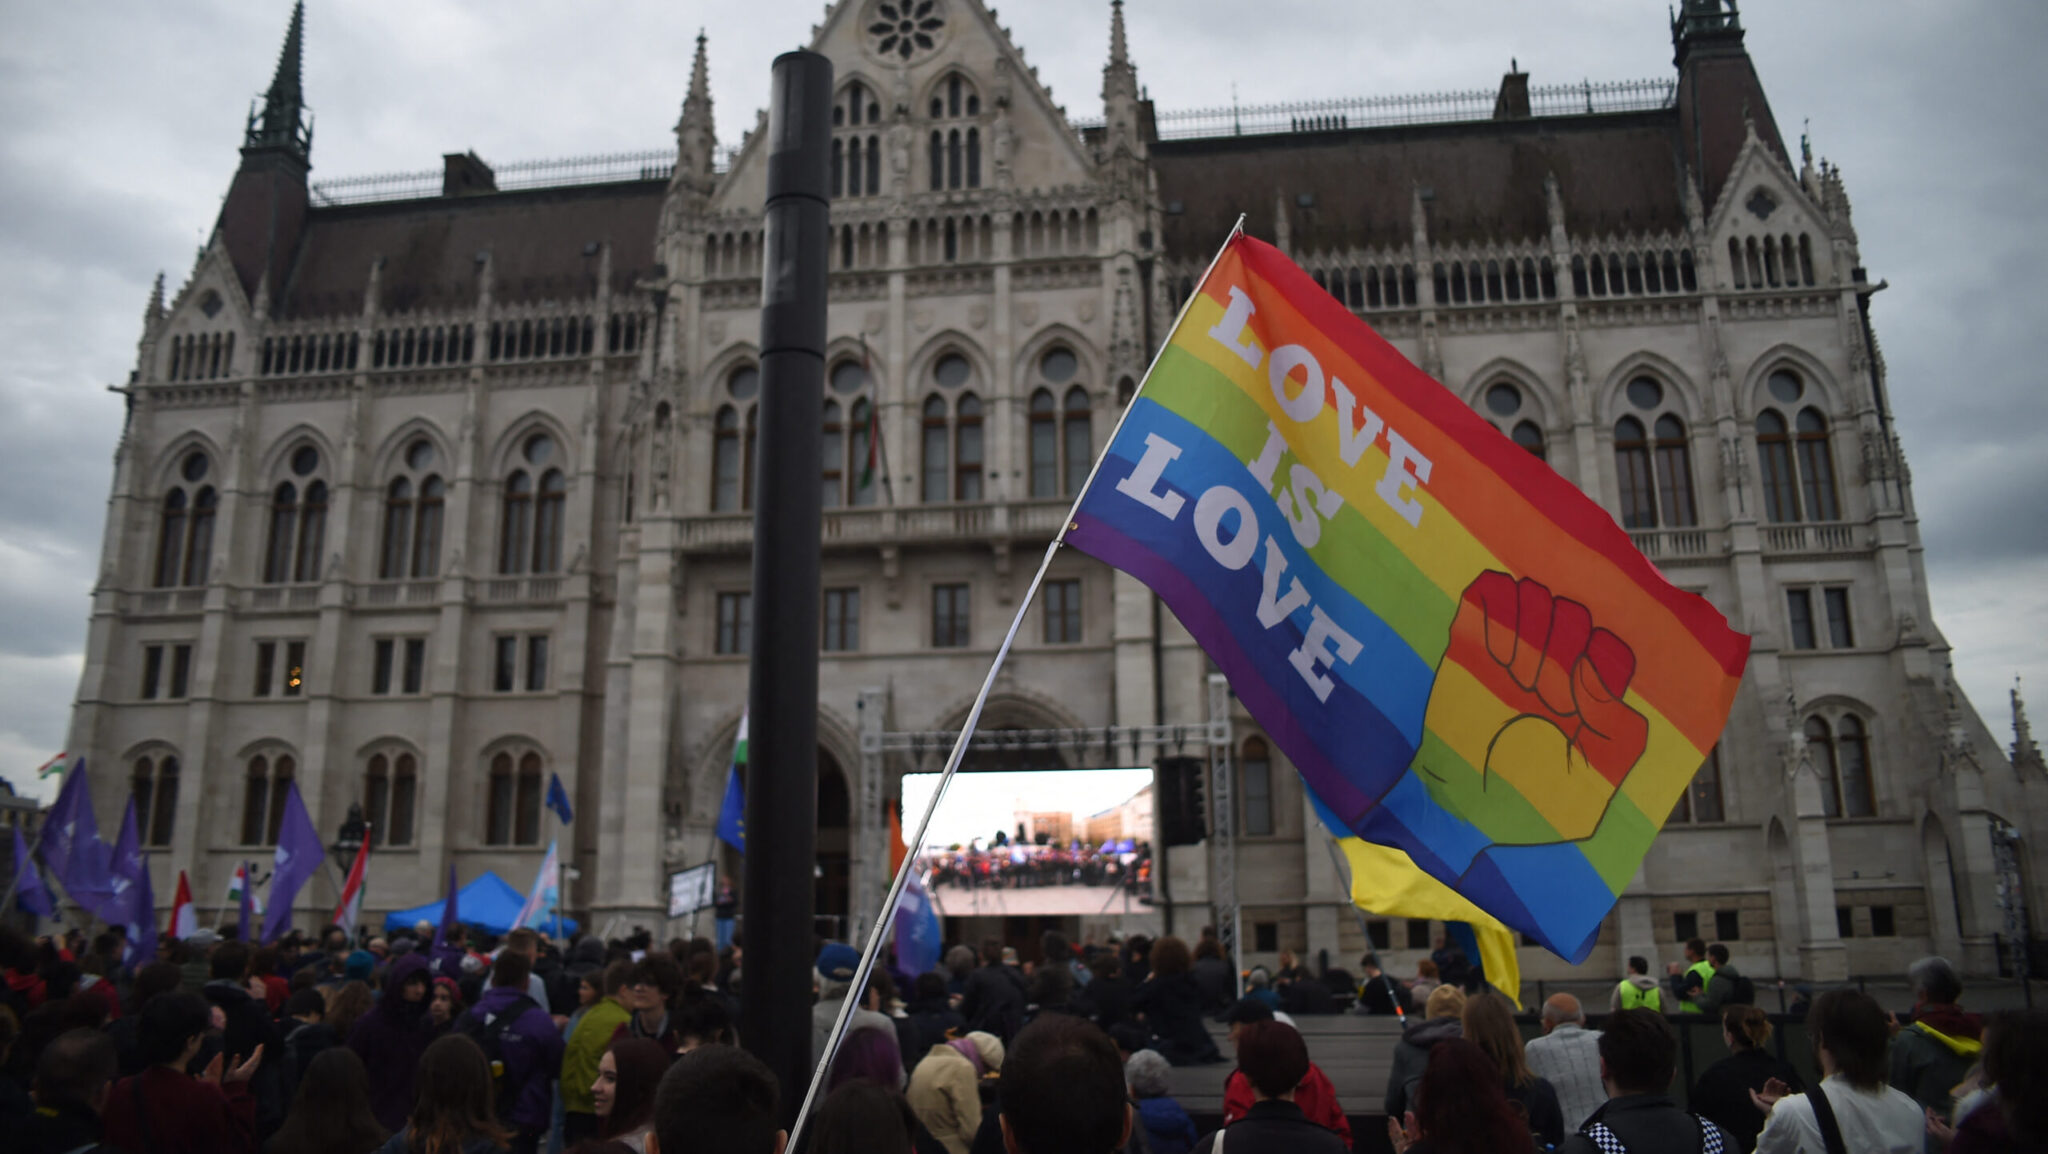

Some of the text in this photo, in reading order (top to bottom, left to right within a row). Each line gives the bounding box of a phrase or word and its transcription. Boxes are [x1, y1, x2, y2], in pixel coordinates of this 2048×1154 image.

[1208, 285, 1433, 529] LOVE
[1247, 420, 1344, 549] IS
[1115, 432, 1364, 704] LOVE
